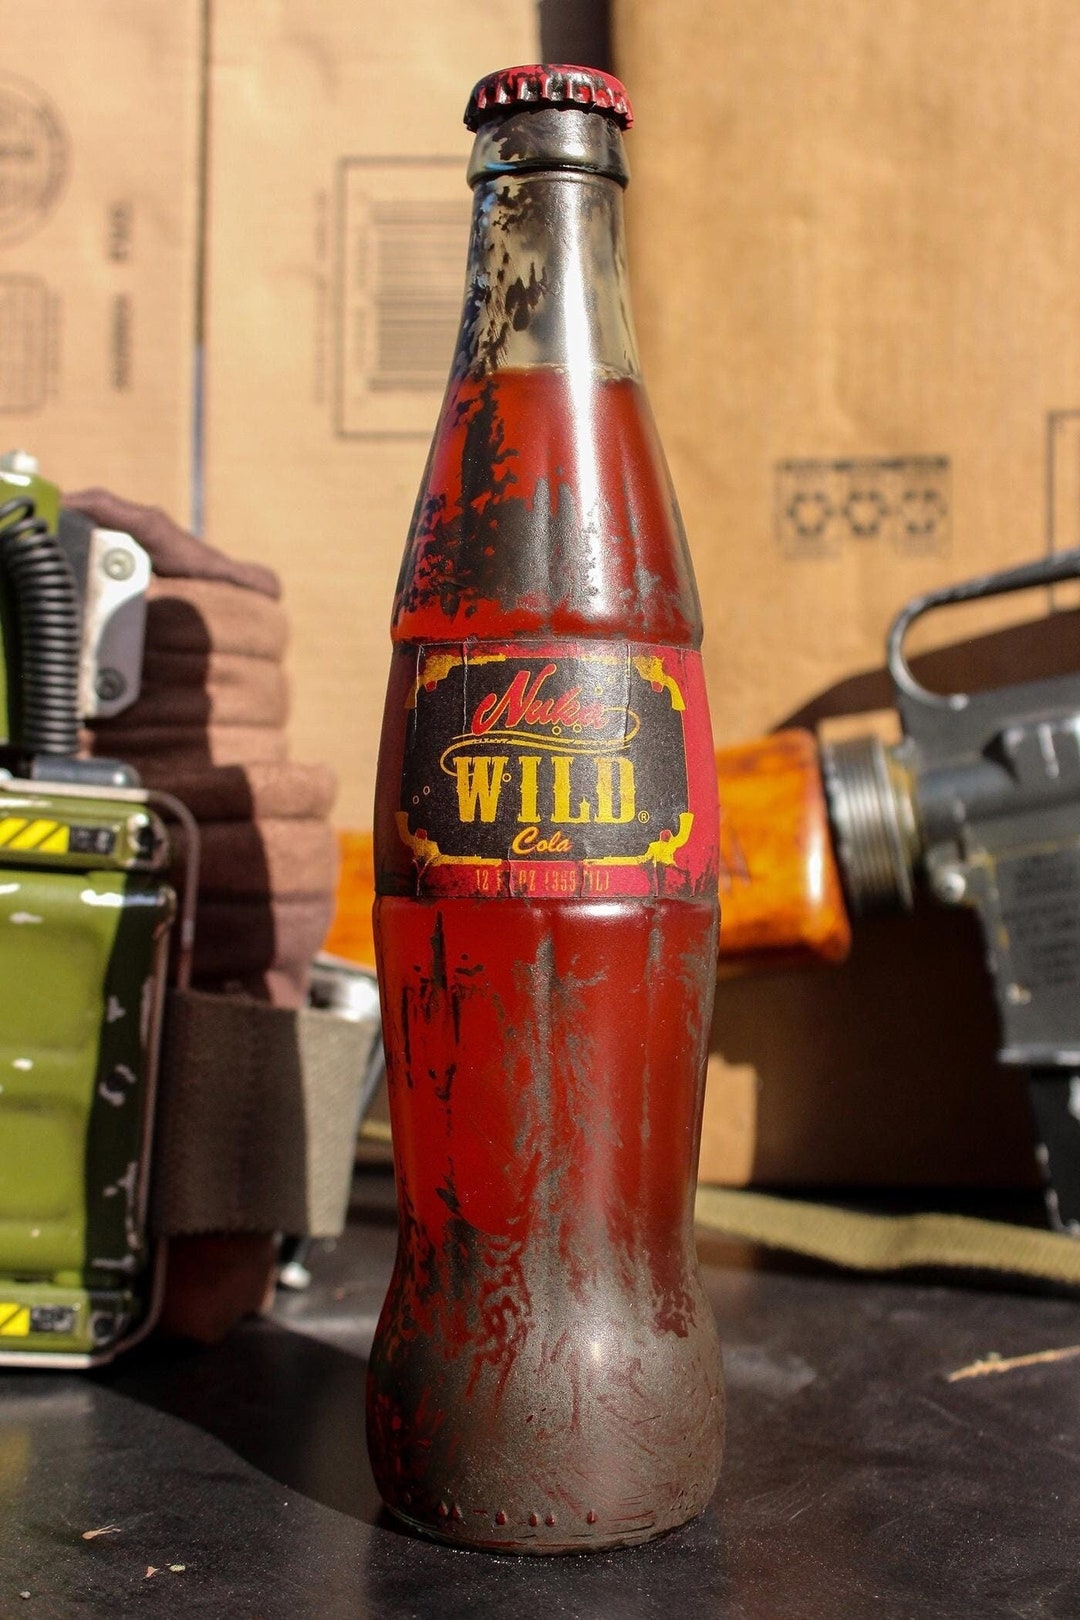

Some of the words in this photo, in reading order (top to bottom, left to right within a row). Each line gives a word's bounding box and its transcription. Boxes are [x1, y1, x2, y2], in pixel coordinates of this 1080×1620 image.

[471, 663, 610, 737] Nuka
[453, 756, 636, 823] WILD
[512, 826, 572, 855] Cola
[475, 869, 489, 891] 12
